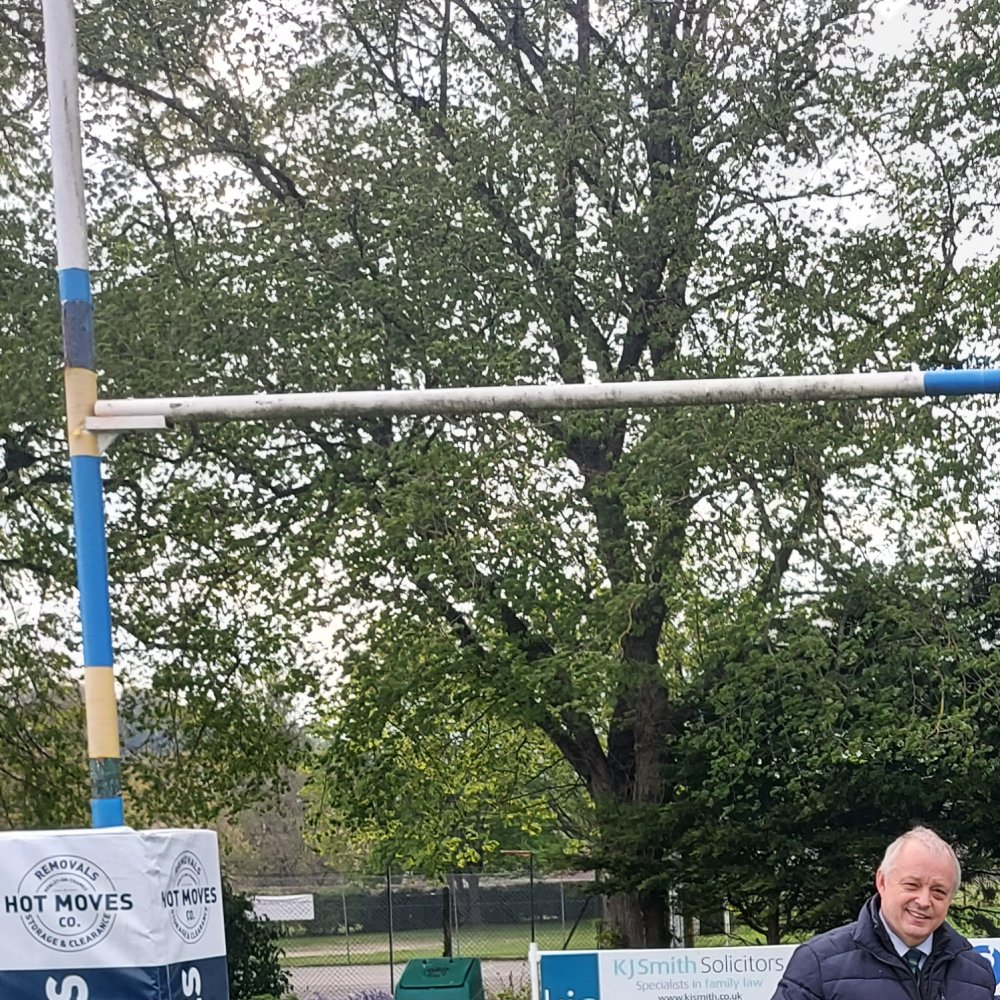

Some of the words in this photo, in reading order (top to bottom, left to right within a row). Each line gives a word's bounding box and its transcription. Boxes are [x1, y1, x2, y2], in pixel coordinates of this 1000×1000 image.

[34, 860, 99, 881] REMOVALS
[5, 894, 47, 913] HOT
[55, 893, 133, 912] MOVES
[182, 887, 217, 906] MOVES
[25, 914, 58, 947] STORAGE
[61, 939, 66, 948] &
[69, 913, 111, 948] CLEARANCE
[59, 916, 81, 928] CO.
[701, 954, 784, 974] Solicitors
[636, 980, 689, 991] Specialists
[692, 979, 702, 989] in
[705, 977, 739, 991] family
[743, 977, 763, 988] law
